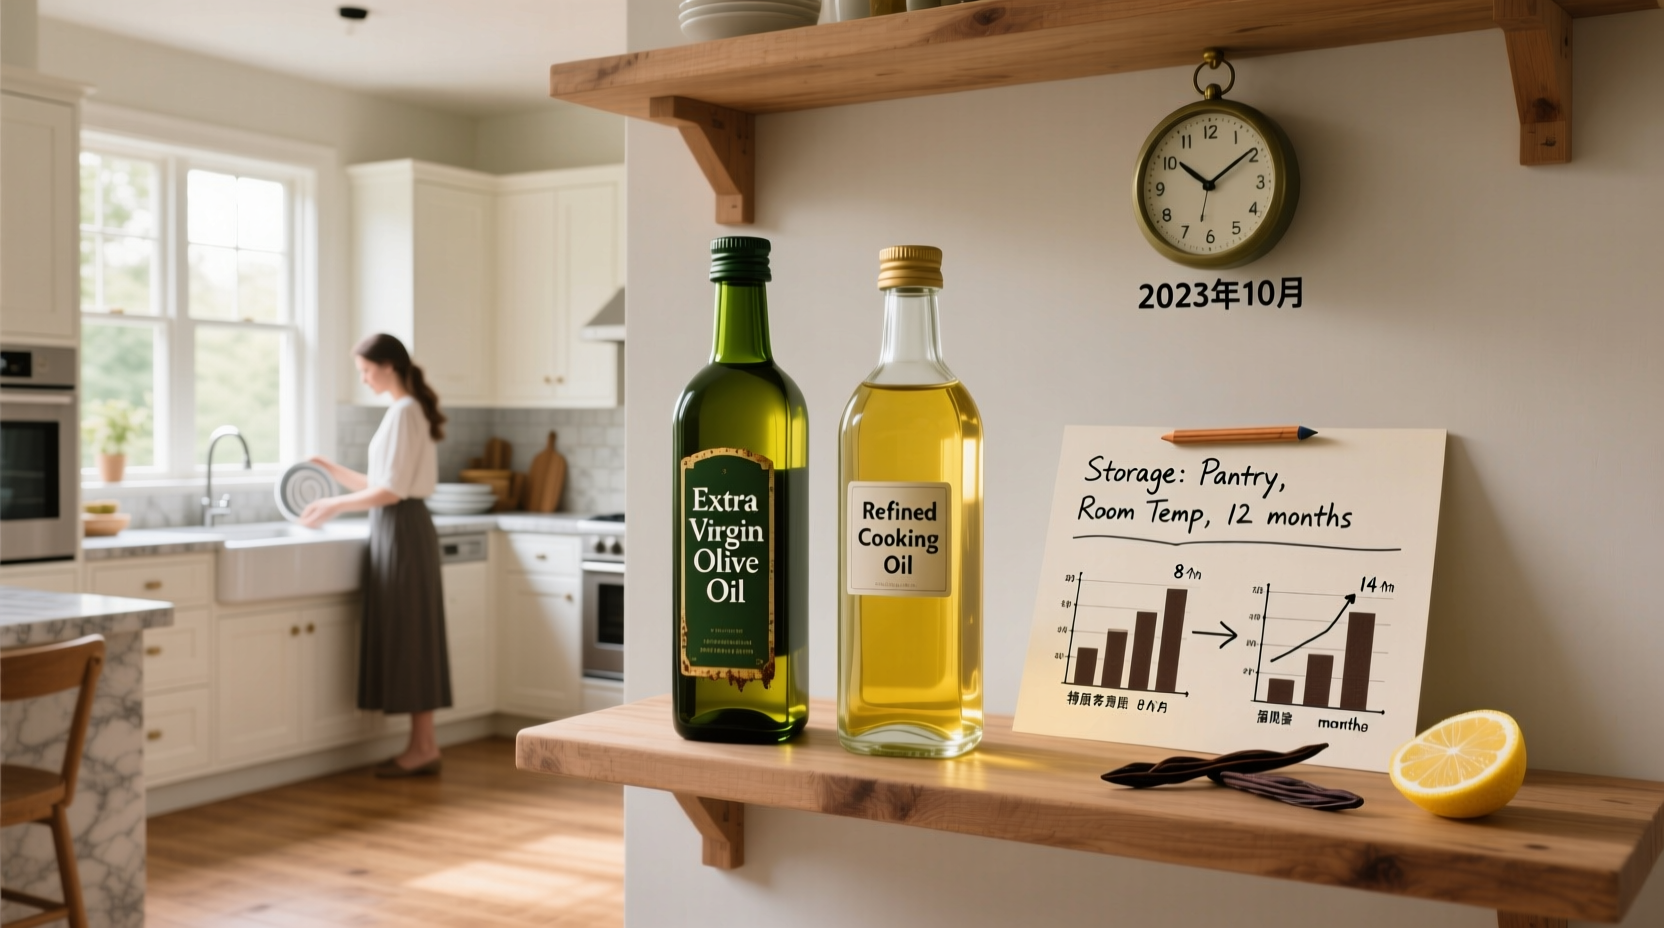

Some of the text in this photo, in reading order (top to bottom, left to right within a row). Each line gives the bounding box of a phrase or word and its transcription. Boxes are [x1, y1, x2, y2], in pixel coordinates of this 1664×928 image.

[1203, 124, 1218, 140] 12
[1181, 134, 1192, 149] 11
[1163, 156, 1178, 170] 10
[1248, 147, 1259, 163] 2
[1155, 181, 1165, 197] 9
[1256, 174, 1265, 190] 3
[1162, 208, 1172, 223] 8
[1248, 201, 1258, 216] 4
[1181, 225, 1190, 239] 7
[1231, 220, 1241, 235] 5
[1205, 229, 1216, 244] 6
[1138, 277, 1303, 311] 2023年10月
[1084, 455, 1286, 499] Storage: Pantry,
[692, 487, 759, 512] Extra
[863, 500, 937, 522] Refined
[1077, 494, 1353, 534] Room Temp, 12 months
[689, 517, 764, 550] Virgin
[858, 527, 939, 555] Cooking
[693, 548, 759, 574] Olive
[883, 555, 913, 575] Oil
[706, 578, 746, 603] Oil
